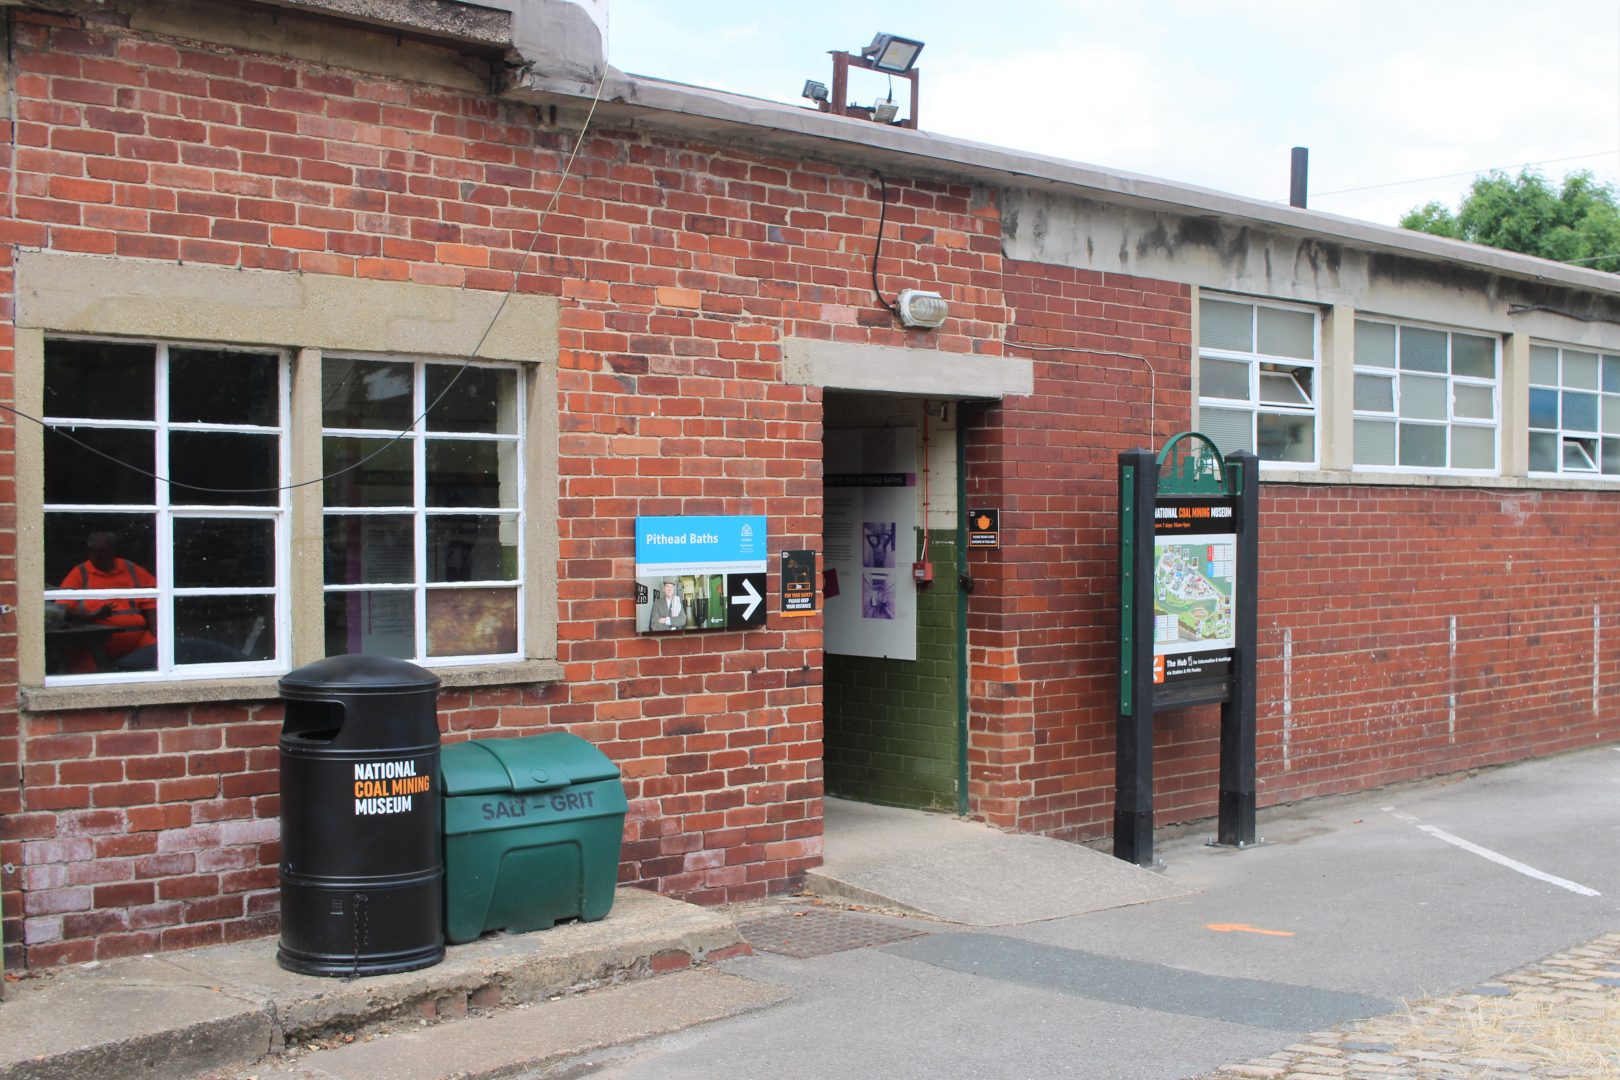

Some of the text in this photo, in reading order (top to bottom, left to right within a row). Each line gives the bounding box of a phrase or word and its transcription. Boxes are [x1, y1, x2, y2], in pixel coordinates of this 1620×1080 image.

[1179, 507, 1191, 518] COAL
[1192, 507, 1210, 518] MINING
[1211, 506, 1232, 518] MUSEUM
[646, 532, 718, 544] Pithead Baths
[1177, 658, 1187, 666] Hub
[354, 760, 416, 780] NATIONAL
[355, 776, 429, 798] COAL MINING
[355, 795, 412, 815] MUSEUM
[482, 798, 526, 820] SALT
[550, 790, 594, 812] GRIT
